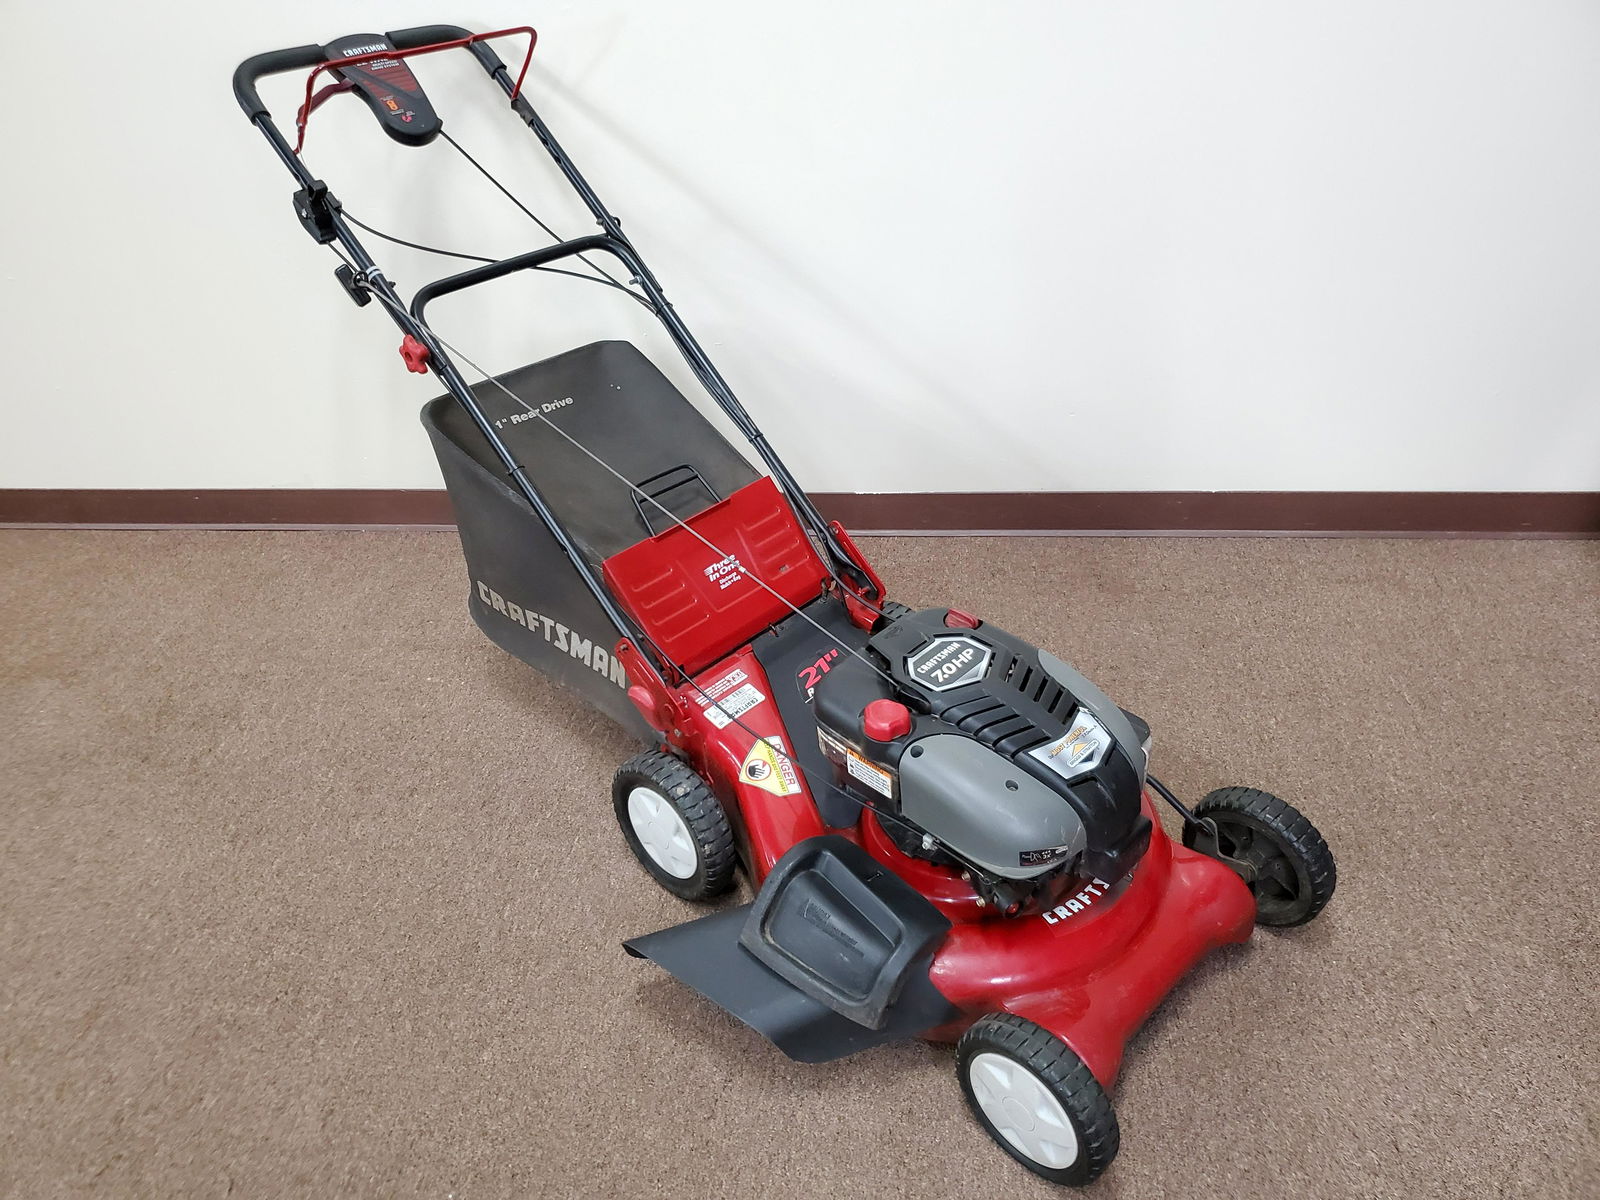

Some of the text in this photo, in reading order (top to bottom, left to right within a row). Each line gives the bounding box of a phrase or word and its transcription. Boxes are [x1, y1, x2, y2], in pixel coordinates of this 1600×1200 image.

[343, 44, 387, 56] CRAFTSMAN
[510, 408, 540, 425] Rear
[541, 397, 574, 413] Drive
[706, 554, 736, 575] Three
[476, 580, 626, 690] CRAFTSMAN
[798, 648, 838, 689] 21"
[917, 641, 961, 675] CRAFTSMAN
